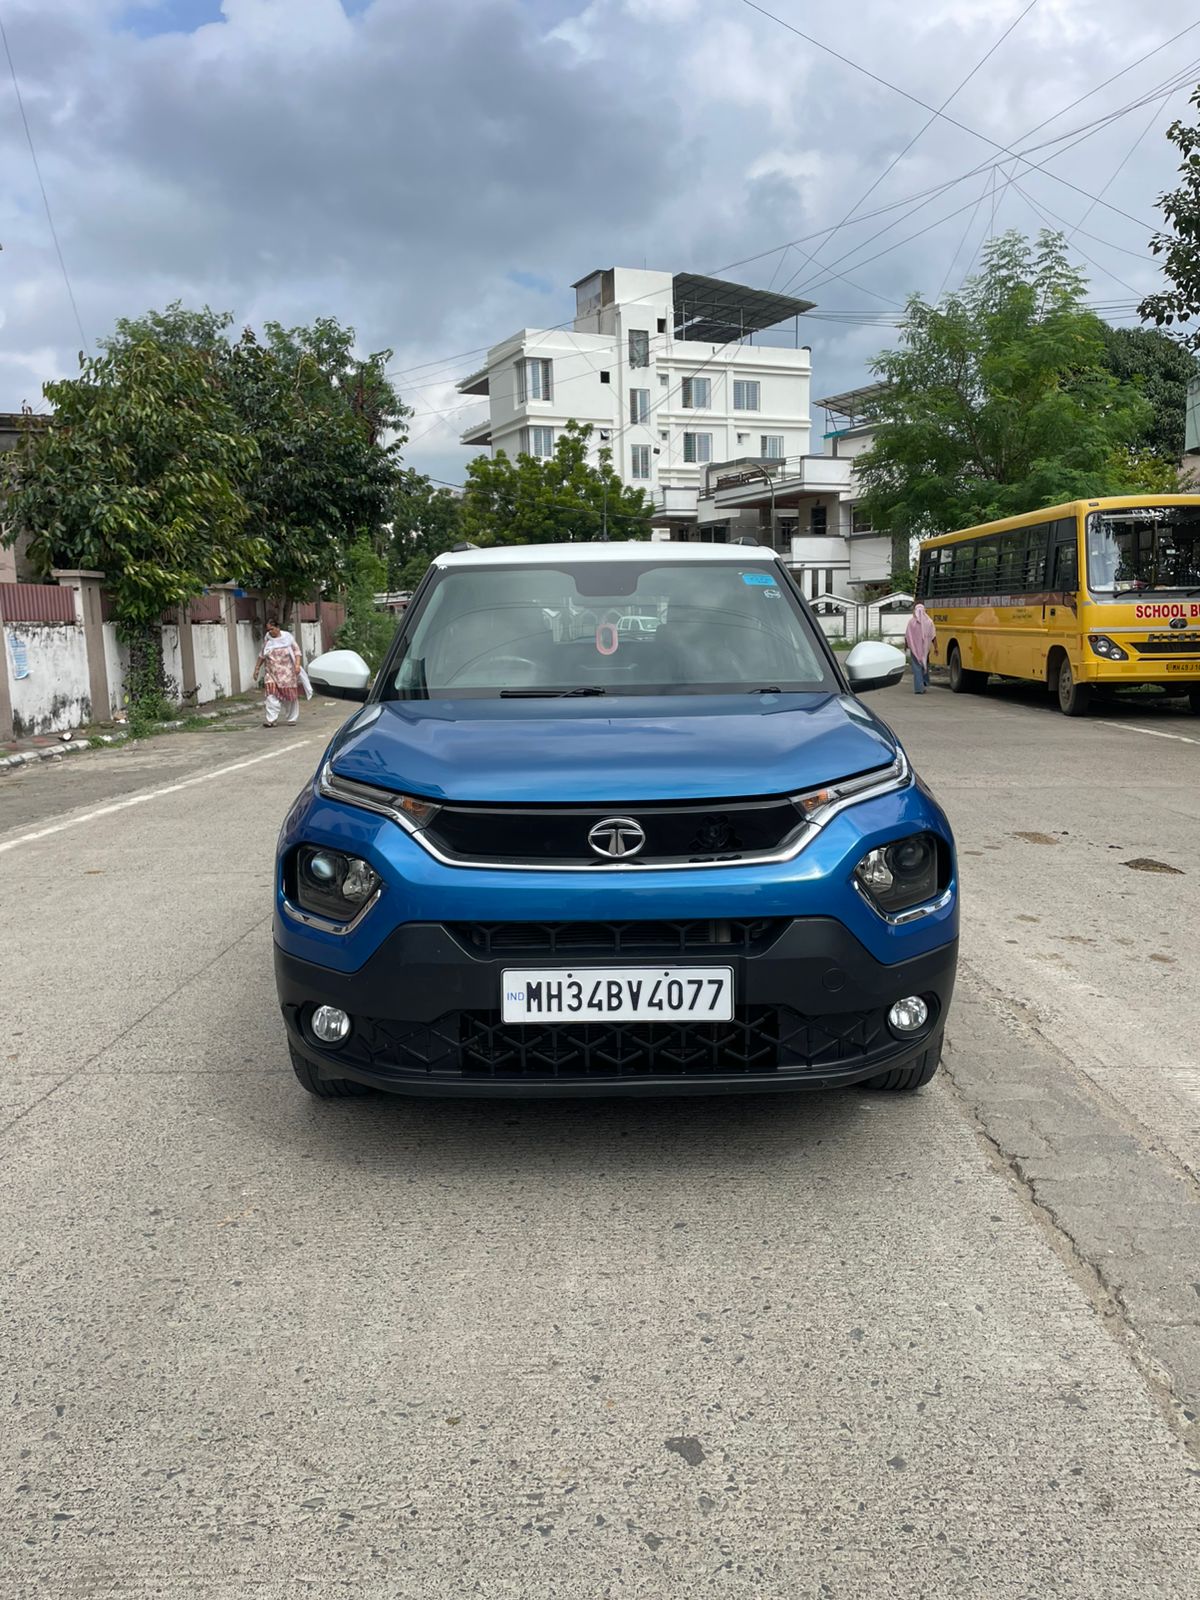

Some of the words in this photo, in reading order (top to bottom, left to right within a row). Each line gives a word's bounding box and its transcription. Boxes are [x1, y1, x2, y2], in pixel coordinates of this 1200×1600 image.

[1136, 604, 1186, 618] SCHOOL
[1190, 604, 1200, 617] B
[506, 991, 525, 1001] IND
[526, 979, 724, 1013] MH34BV4077
